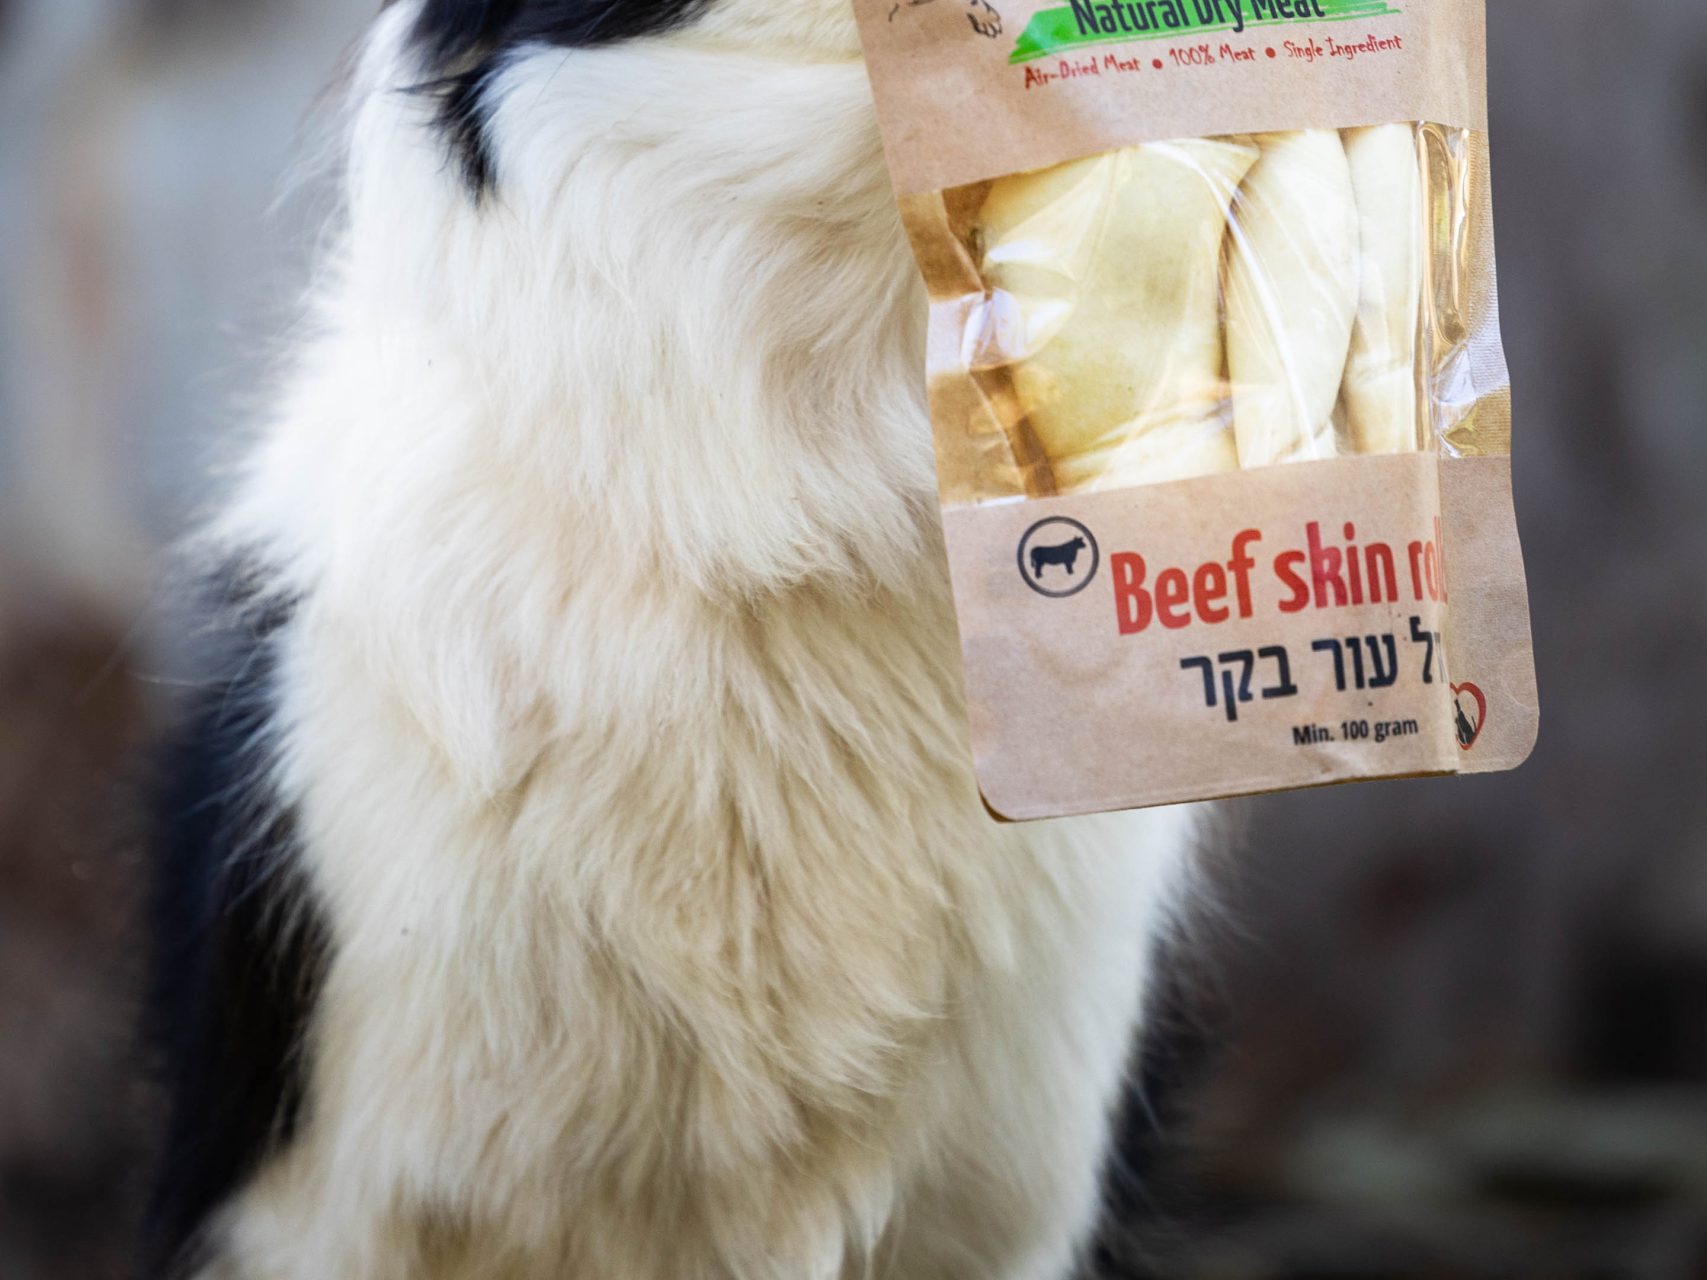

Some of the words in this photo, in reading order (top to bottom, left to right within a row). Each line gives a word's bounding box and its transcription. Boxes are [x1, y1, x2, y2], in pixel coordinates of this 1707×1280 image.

[1024, 55, 1100, 89] Air-Dried
[1103, 53, 1141, 72] Meat
[1169, 44, 1216, 66] 100%
[1219, 42, 1256, 63] Meat
[1283, 37, 1324, 63] Single
[1325, 33, 1403, 61] Ingredient
[1110, 528, 1263, 637] Beef
[1272, 520, 1399, 614] skin
[1179, 644, 1298, 723] בקר
[1311, 633, 1399, 692] עור
[1292, 722, 1335, 746] Min.
[1341, 719, 1369, 740] 100
[1374, 718, 1419, 743] gram
